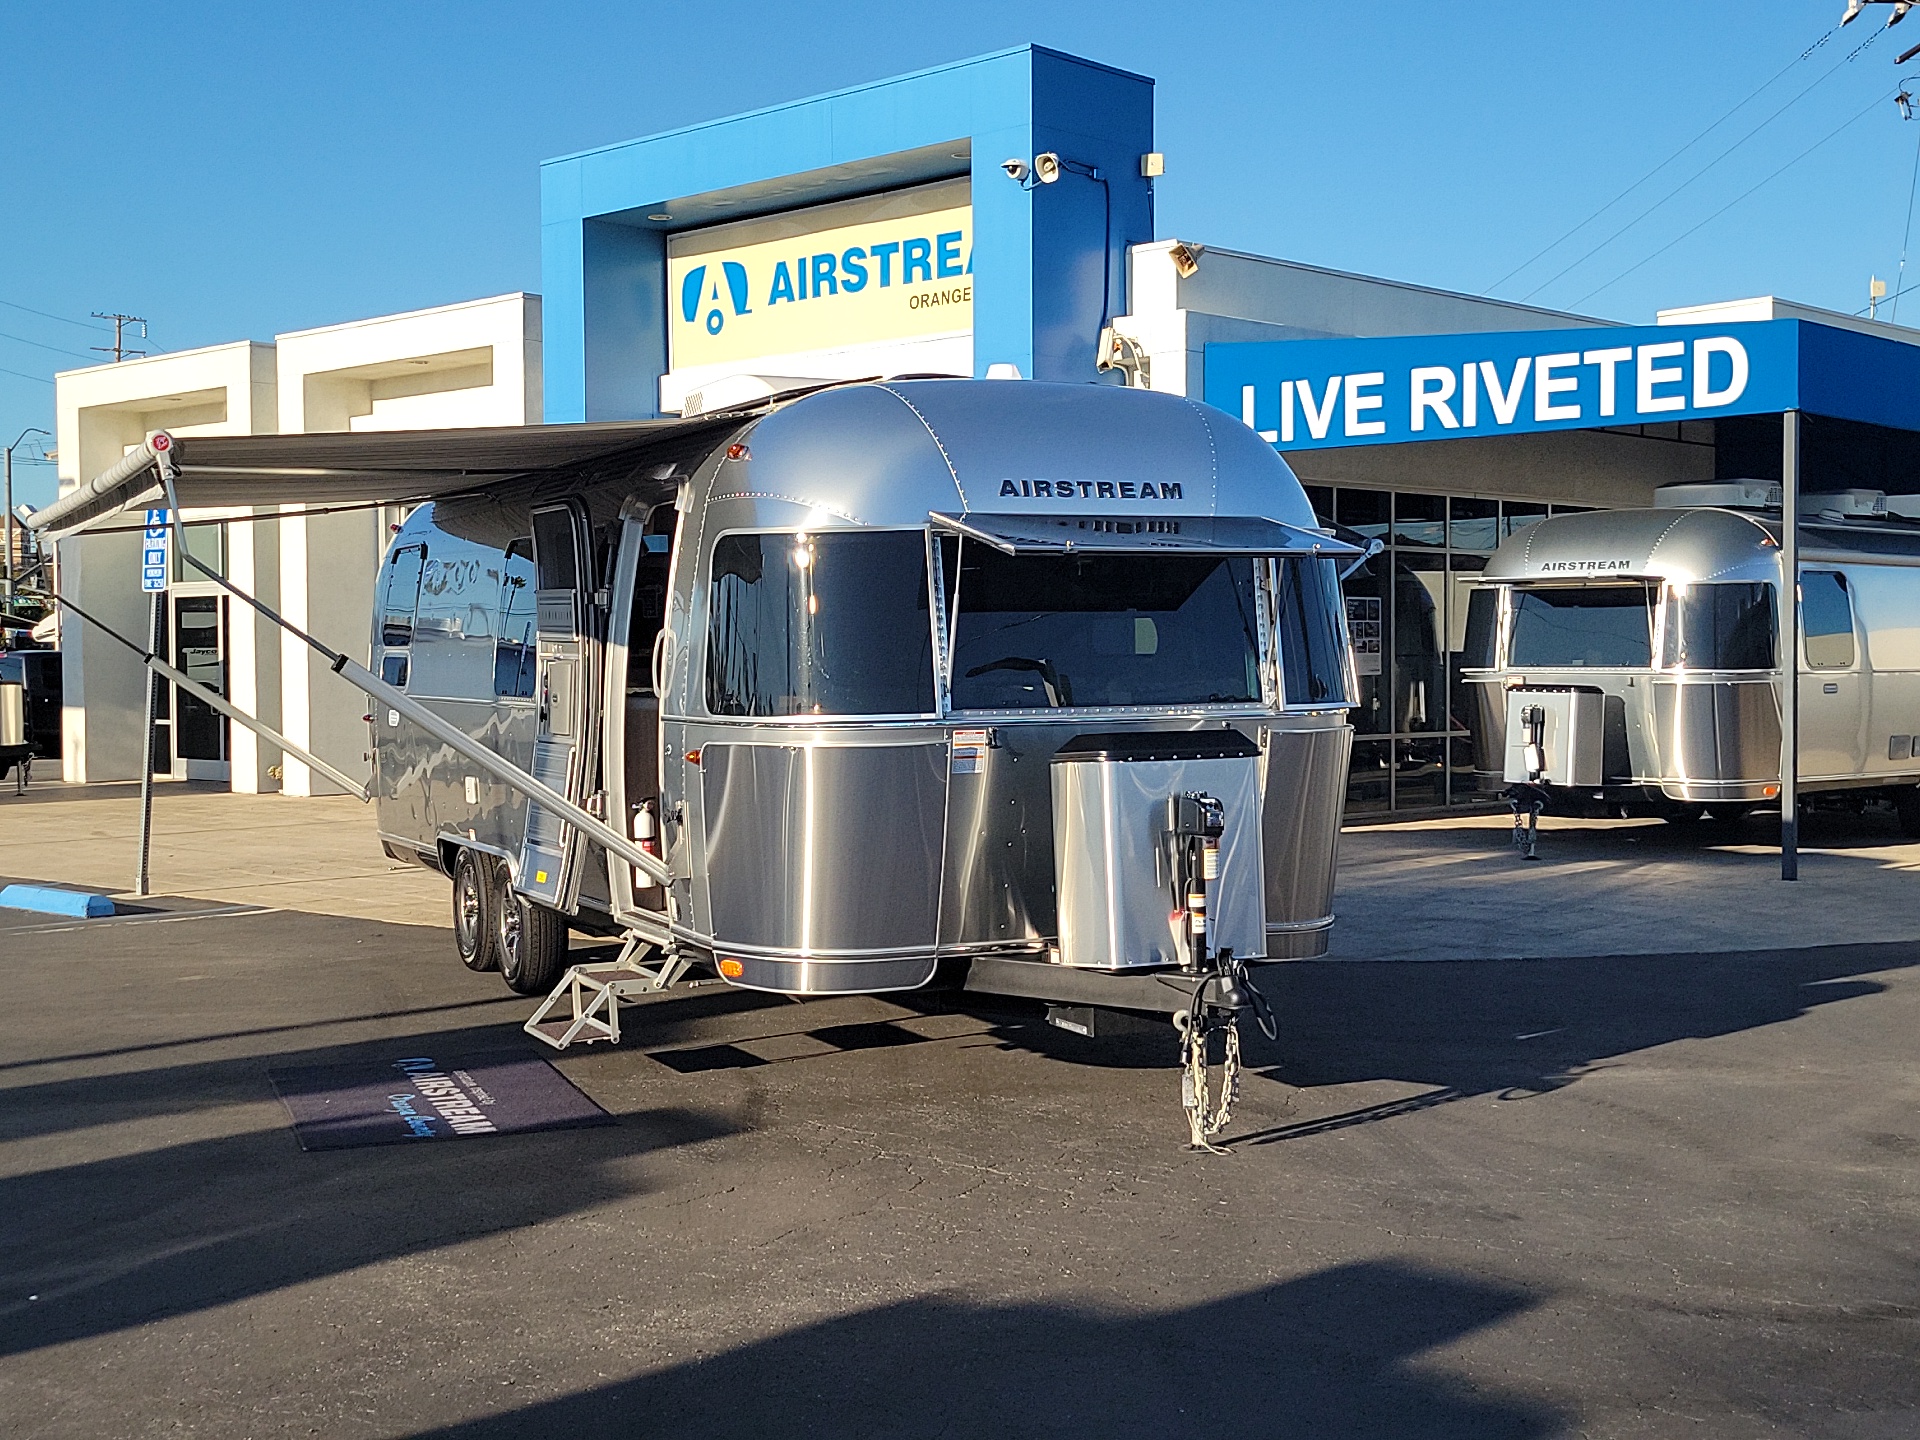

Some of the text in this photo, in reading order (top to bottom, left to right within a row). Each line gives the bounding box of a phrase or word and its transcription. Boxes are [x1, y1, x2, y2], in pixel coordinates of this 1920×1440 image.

[768, 230, 972, 306] AIRSTRE
[909, 286, 971, 309] ORANGE
[1242, 336, 1749, 443] LIVE RIVETED
[999, 479, 1182, 500] AIRSTREAM
[1541, 560, 1630, 571] AIRSTREAM
[189, 648, 217, 656] Jayco
[406, 1072, 498, 1135] AIRSTREAM
